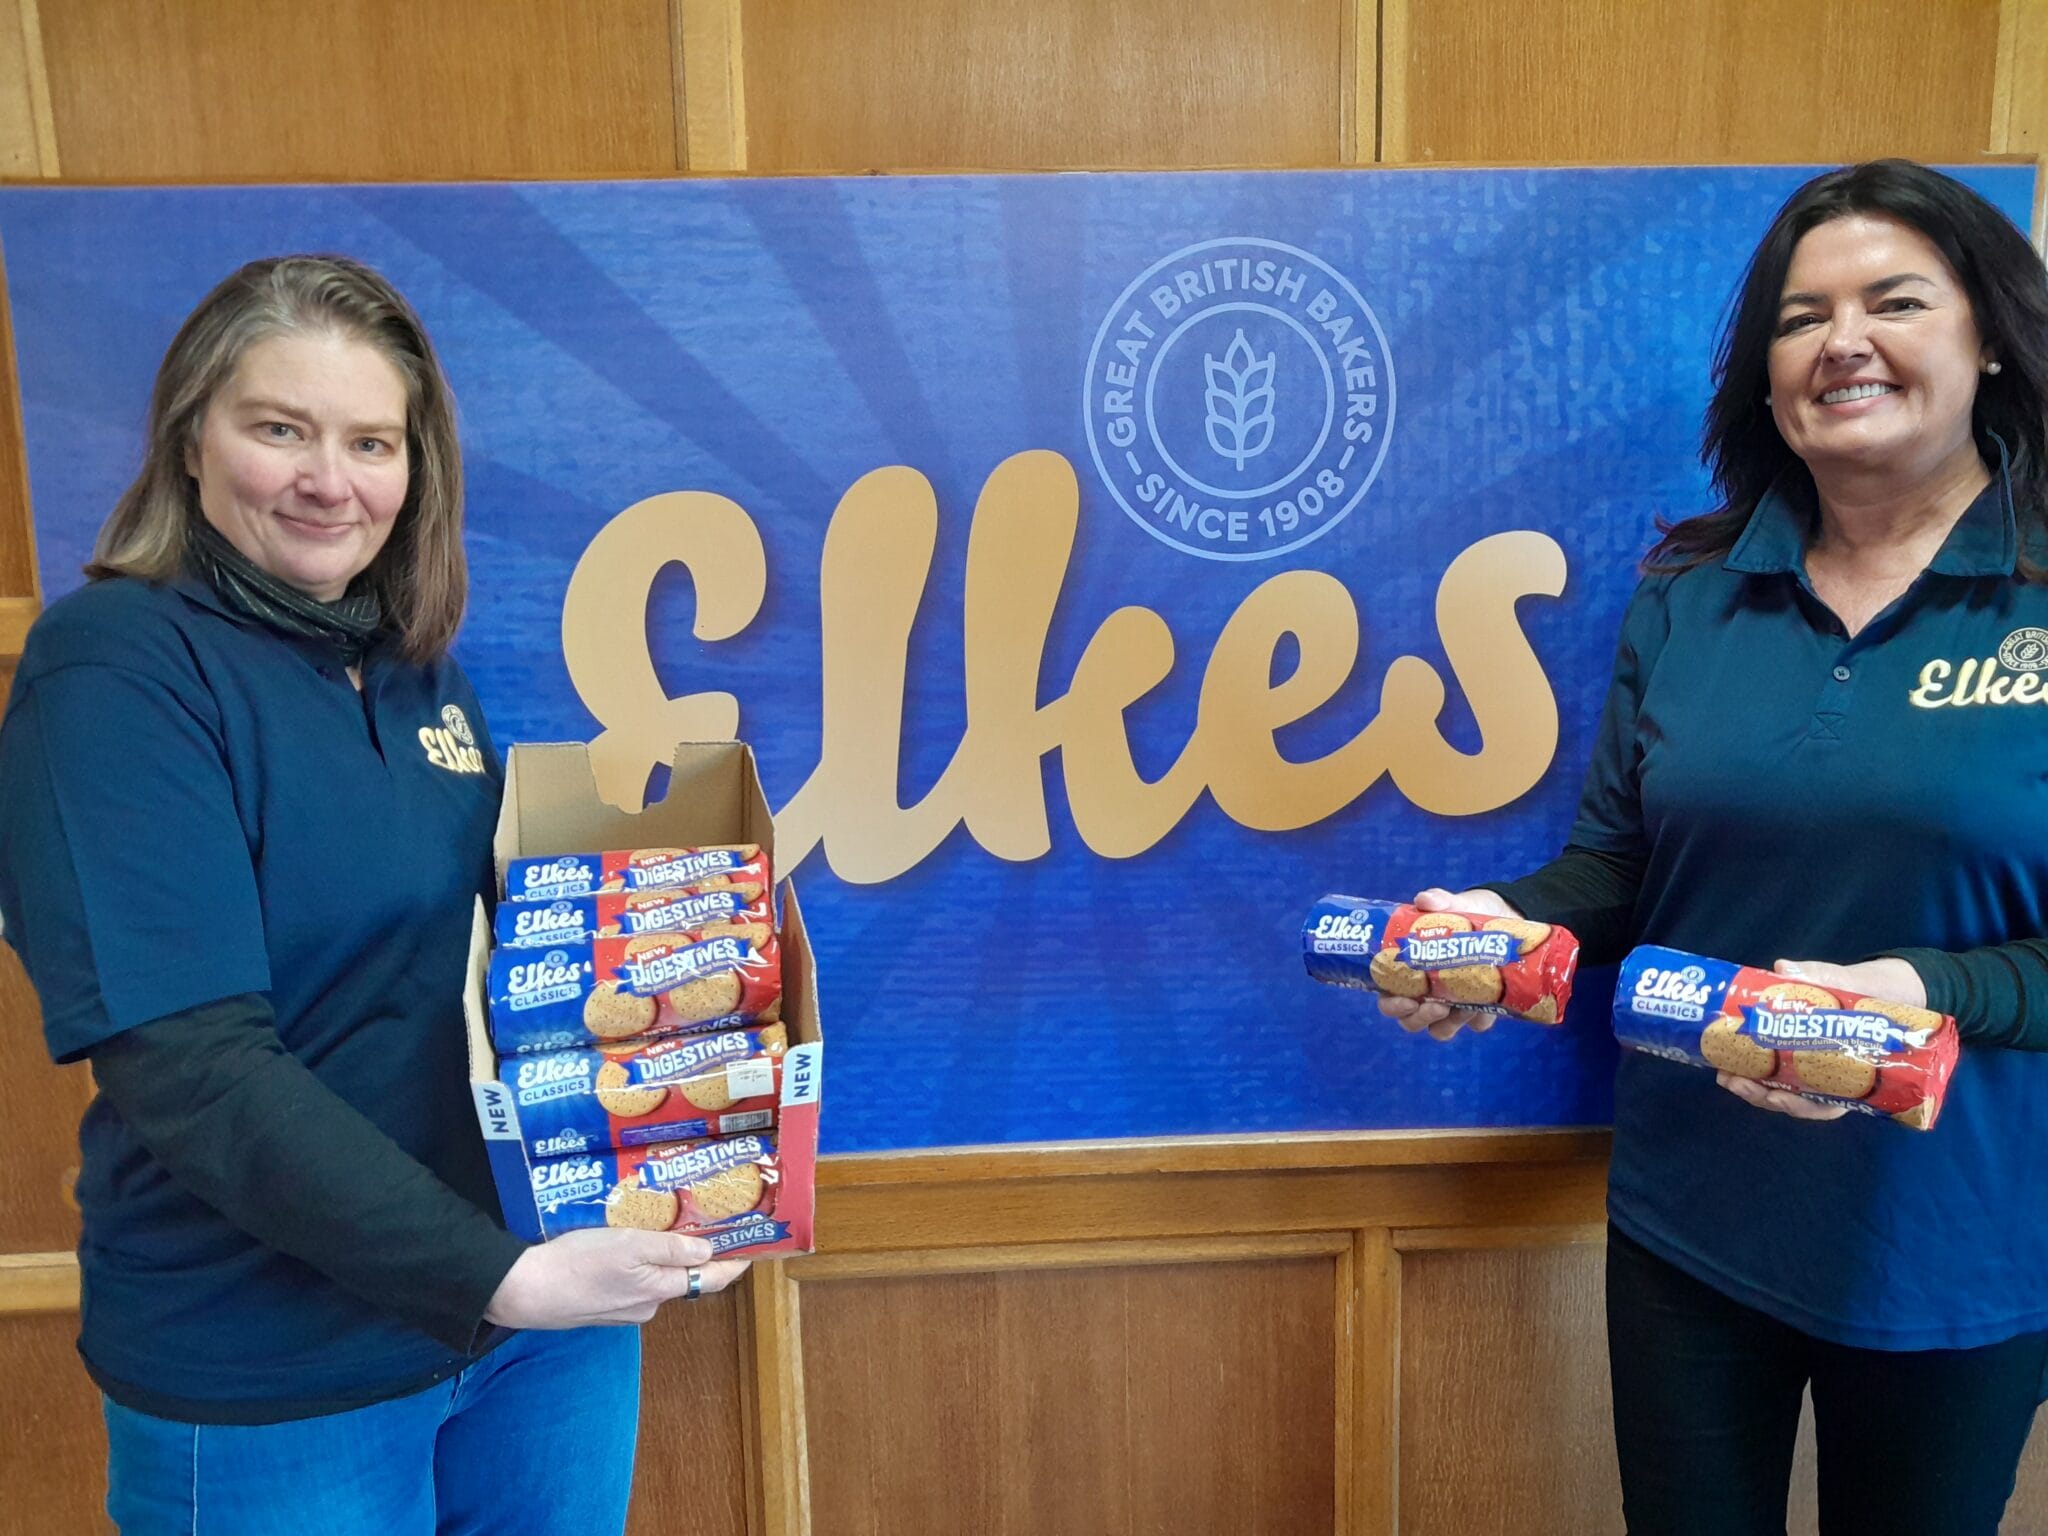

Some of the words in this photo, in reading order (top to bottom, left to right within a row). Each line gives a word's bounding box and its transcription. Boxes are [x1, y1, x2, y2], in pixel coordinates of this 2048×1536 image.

[1104, 310, 1156, 447] GREAT
[1150, 258, 1307, 319] BRITISH
[1306, 288, 1377, 443] BAKERS
[1136, 473, 1249, 541] SINCE
[1258, 469, 1345, 537] 1908
[562, 449, 1567, 885] Elkes
[640, 855, 667, 866] NEW
[524, 864, 590, 888] Elkes
[637, 898, 665, 910] NEW
[515, 909, 584, 936] Elkes
[1315, 915, 1373, 940] Elkes
[1420, 927, 1447, 937] NEW
[637, 947, 666, 963] NEW
[1317, 942, 1365, 953] CLASSICS
[508, 961, 580, 994] Elkes
[1635, 968, 1712, 1005] Elkes
[514, 986, 577, 1007] CLASSICS
[1772, 996, 1807, 1012] NEW
[1636, 1000, 1698, 1019] CLASSICS
[647, 1041, 676, 1056] NEW
[1777, 1039, 1811, 1047] perfect
[518, 1058, 589, 1088] Elkes
[794, 1053, 812, 1098] NEW
[524, 1081, 585, 1102] CLASSICS
[483, 1089, 510, 1133] NEW
[535, 1137, 587, 1153] Elkes
[659, 1145, 689, 1157] NEW
[532, 1161, 603, 1191] Elkes
[537, 1182, 598, 1204] CLASSICS
